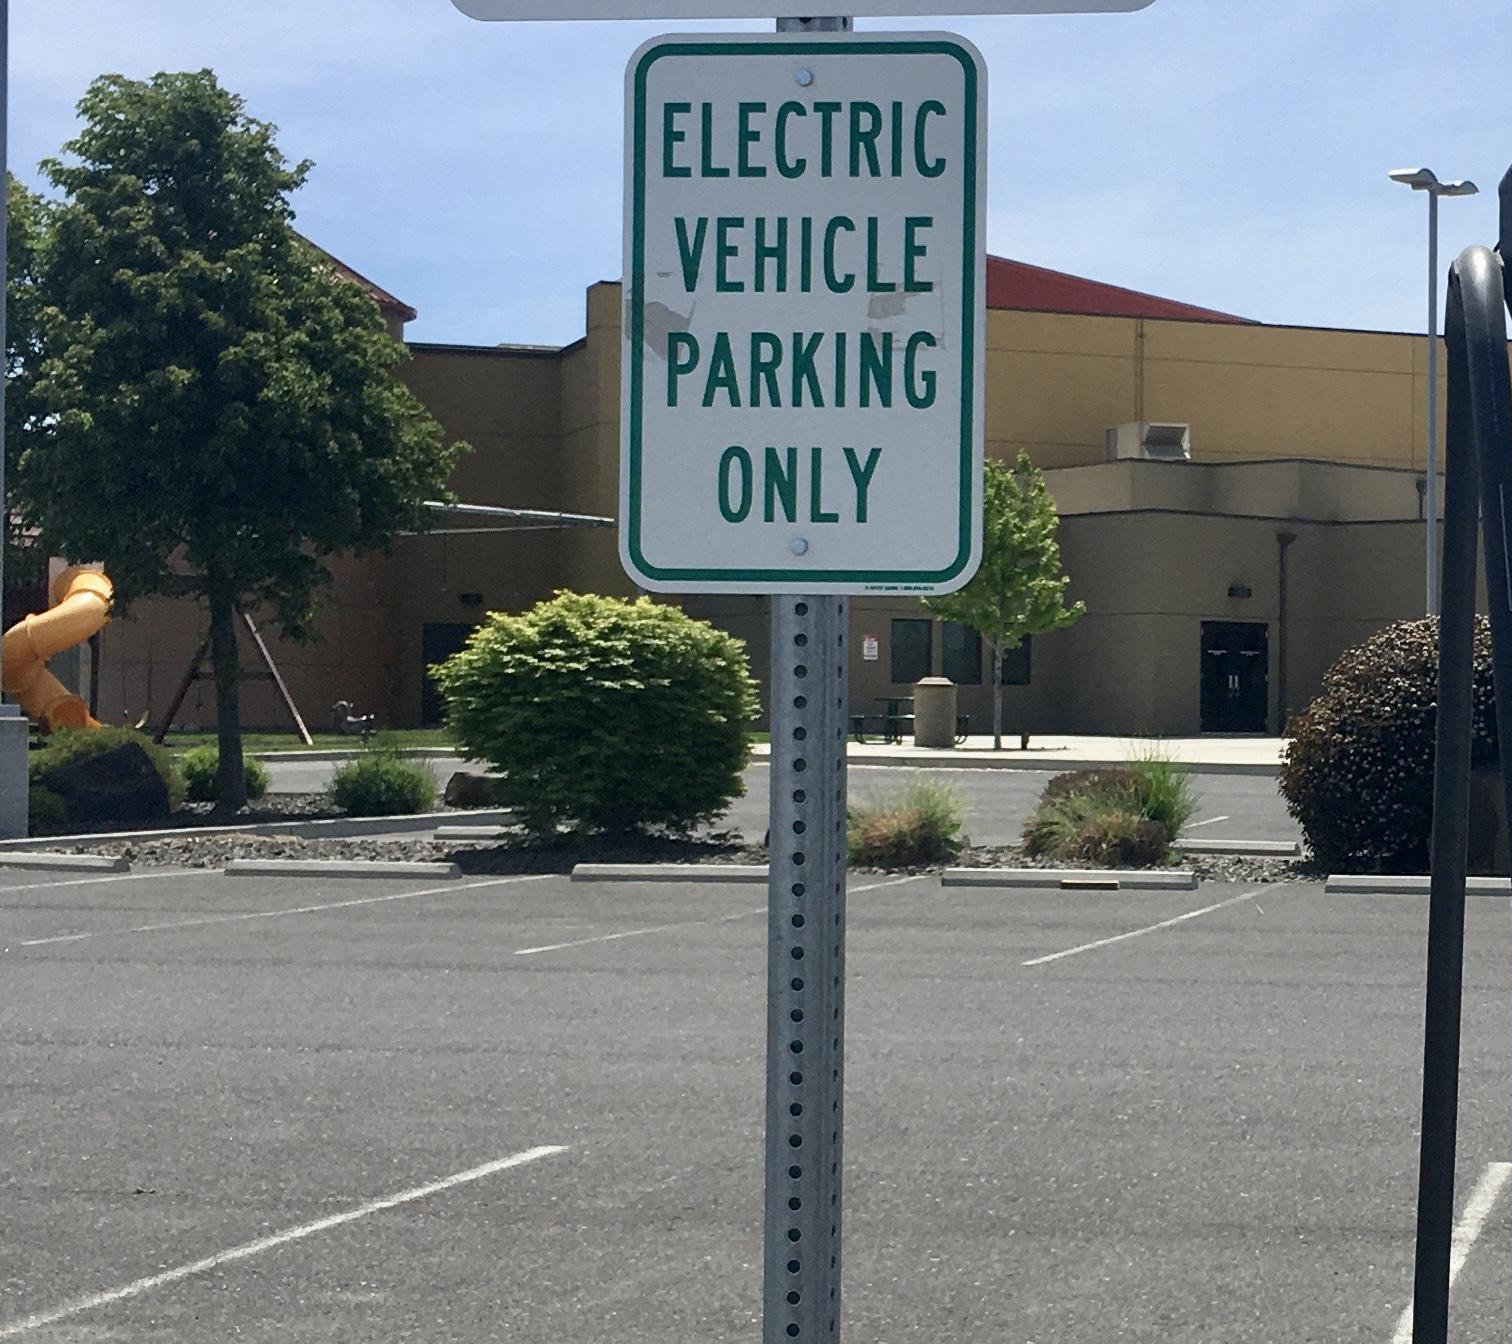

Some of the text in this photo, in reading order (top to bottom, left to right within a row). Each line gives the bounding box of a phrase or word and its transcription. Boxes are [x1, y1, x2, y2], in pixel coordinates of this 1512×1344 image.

[663, 100, 946, 178] ELECTRIC
[674, 216, 933, 293] VEHICLE
[667, 331, 936, 409] PARKING
[718, 446, 882, 523] ONLY
